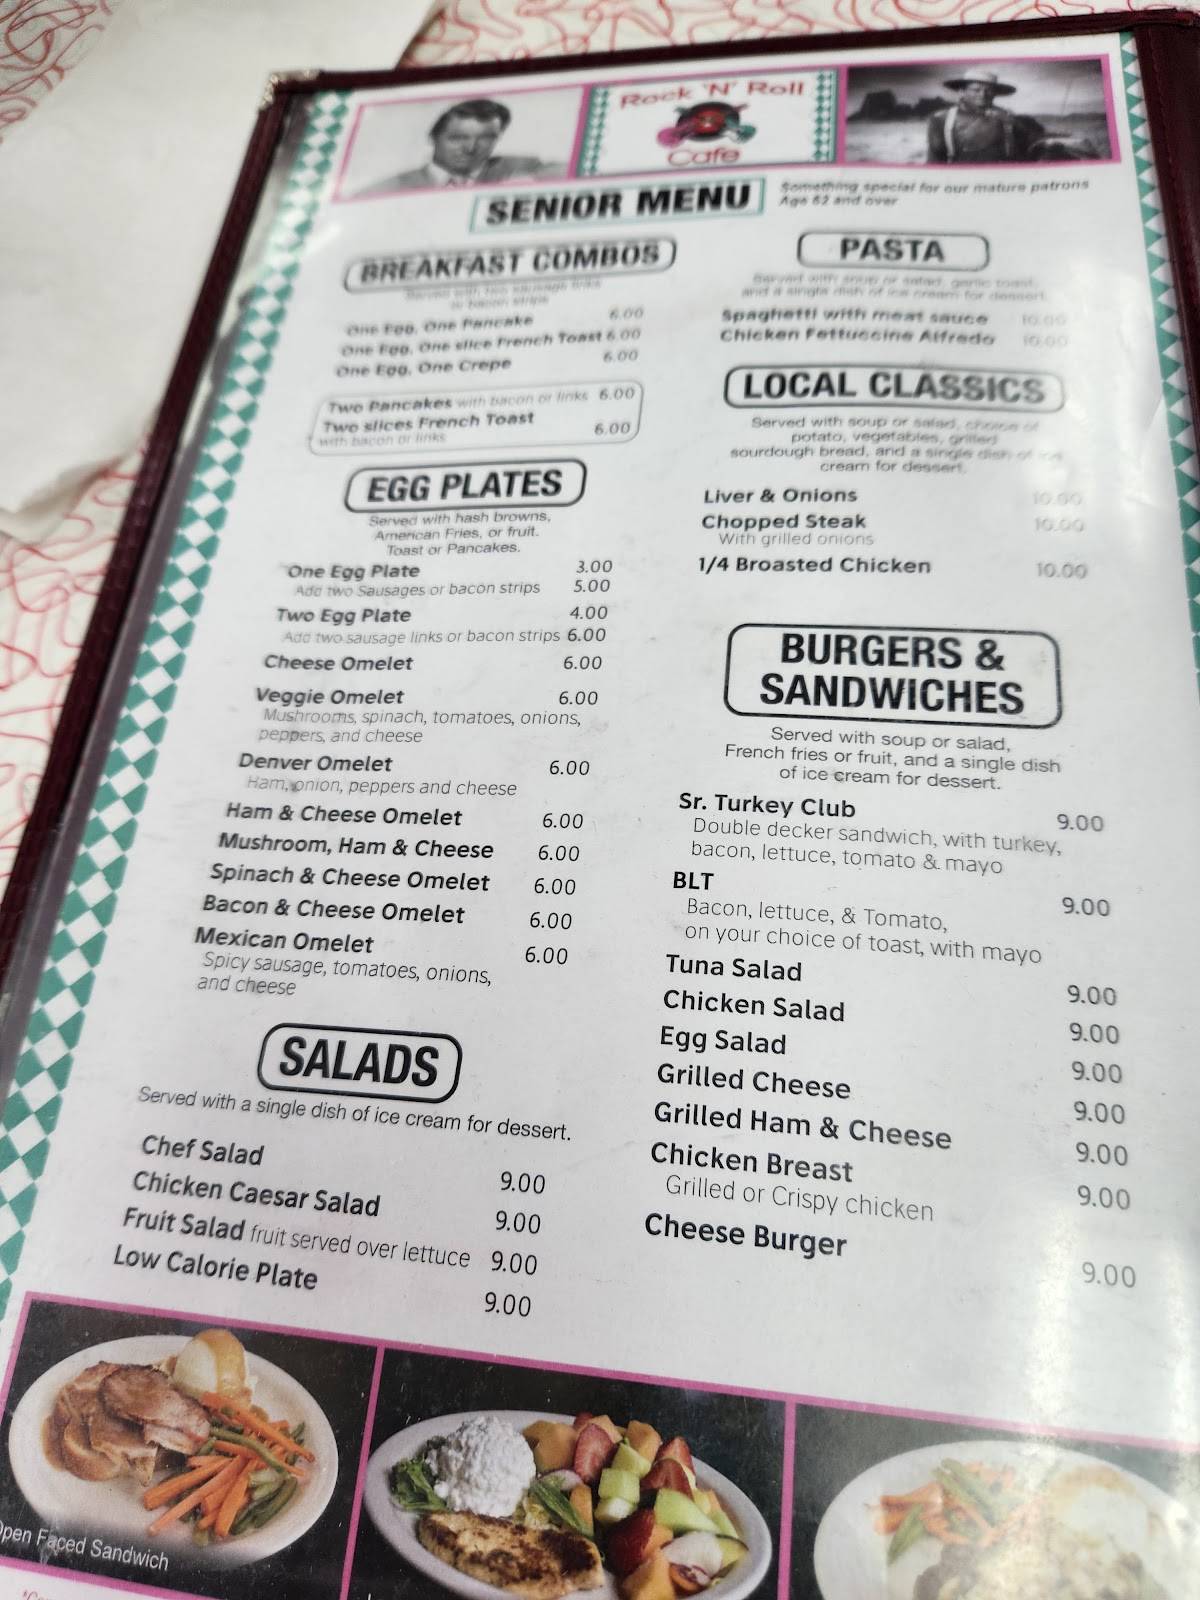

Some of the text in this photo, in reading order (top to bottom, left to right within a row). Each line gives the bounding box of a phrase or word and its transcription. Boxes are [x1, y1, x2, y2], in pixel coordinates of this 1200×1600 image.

[621, 87, 690, 108] Rock
[747, 80, 804, 96] Roll
[667, 147, 741, 166] Cafe
[919, 182, 940, 193] for
[1030, 180, 1089, 194] patrons
[487, 184, 750, 224] SENIOR MENU
[361, 243, 659, 283] BREAKFAST COMBOS
[841, 237, 944, 262] PASTA
[722, 307, 988, 325] Spaghetti with meat sauce
[720, 328, 800, 342] Chicken
[919, 329, 995, 345] Alfredo
[336, 365, 370, 377] One
[418, 361, 453, 373] One
[458, 359, 512, 372] Crepe
[603, 349, 639, 362] 6.00
[744, 371, 1044, 403] LOCAL CLASSICS
[323, 412, 631, 435] Two slices French Toast 6.00
[820, 462, 870, 472] cream
[876, 459, 897, 472] for
[367, 469, 562, 502] EGG PLATES
[704, 488, 857, 504] Liver & Onions
[370, 516, 417, 526] Served
[422, 514, 450, 524] with
[456, 512, 489, 523] hash
[374, 530, 440, 541] American
[488, 528, 503, 538] or
[702, 514, 866, 532] Chopped Steak
[387, 542, 520, 556] Toast or Pancakes.
[719, 532, 874, 548] With grilled onions
[287, 560, 613, 582] One Egg Plate 3.00
[699, 556, 1088, 579] 1/4 Broasted Chicken 10.00
[277, 606, 608, 626] Two Egg Plate 4.00
[264, 654, 602, 671] Cheese Omelet 6.00
[781, 633, 1004, 671] BURGERS &
[760, 673, 1024, 715] SANDWICHES
[771, 726, 1011, 753] Served with soup or salad,
[679, 792, 1104, 832] Sr. Turkey Club 9.00
[218, 832, 580, 862] Mushroom, Ham & Cheese 6.00
[673, 871, 1110, 917] BLT 9.00
[688, 898, 947, 934] Bacon, lettuce, & Tomato,
[194, 926, 568, 965] Mexican Omelet 6.00
[666, 954, 1117, 1006] Tuna Salad 9.00
[279, 1036, 439, 1087] SALADS
[658, 1063, 1125, 1125] Grilled Cheese 9.00
[138, 1086, 570, 1141] Served with a single dish of ice cream for dessert.
[142, 1135, 545, 1194] Chef Salad 9.00
[651, 1142, 1131, 1210] Chicken Breast 9.00
[133, 1171, 541, 1234] Chicken Caesar Salad 9.00
[666, 1174, 933, 1221] Grilled or Crispy chicken
[123, 1207, 176, 1233] Fruit
[180, 1213, 246, 1241] Salad
[250, 1224, 287, 1247] fruit
[290, 1233, 352, 1254] served
[403, 1241, 470, 1268] lettuce
[492, 1250, 537, 1275] 9.00
[645, 1213, 1137, 1289] Cheese Burger 9.00
[114, 1244, 531, 1317] Low Calorie Plate 9.00
[36, 1528, 87, 1555] Faced
[90, 1539, 169, 1571] Sandwich
